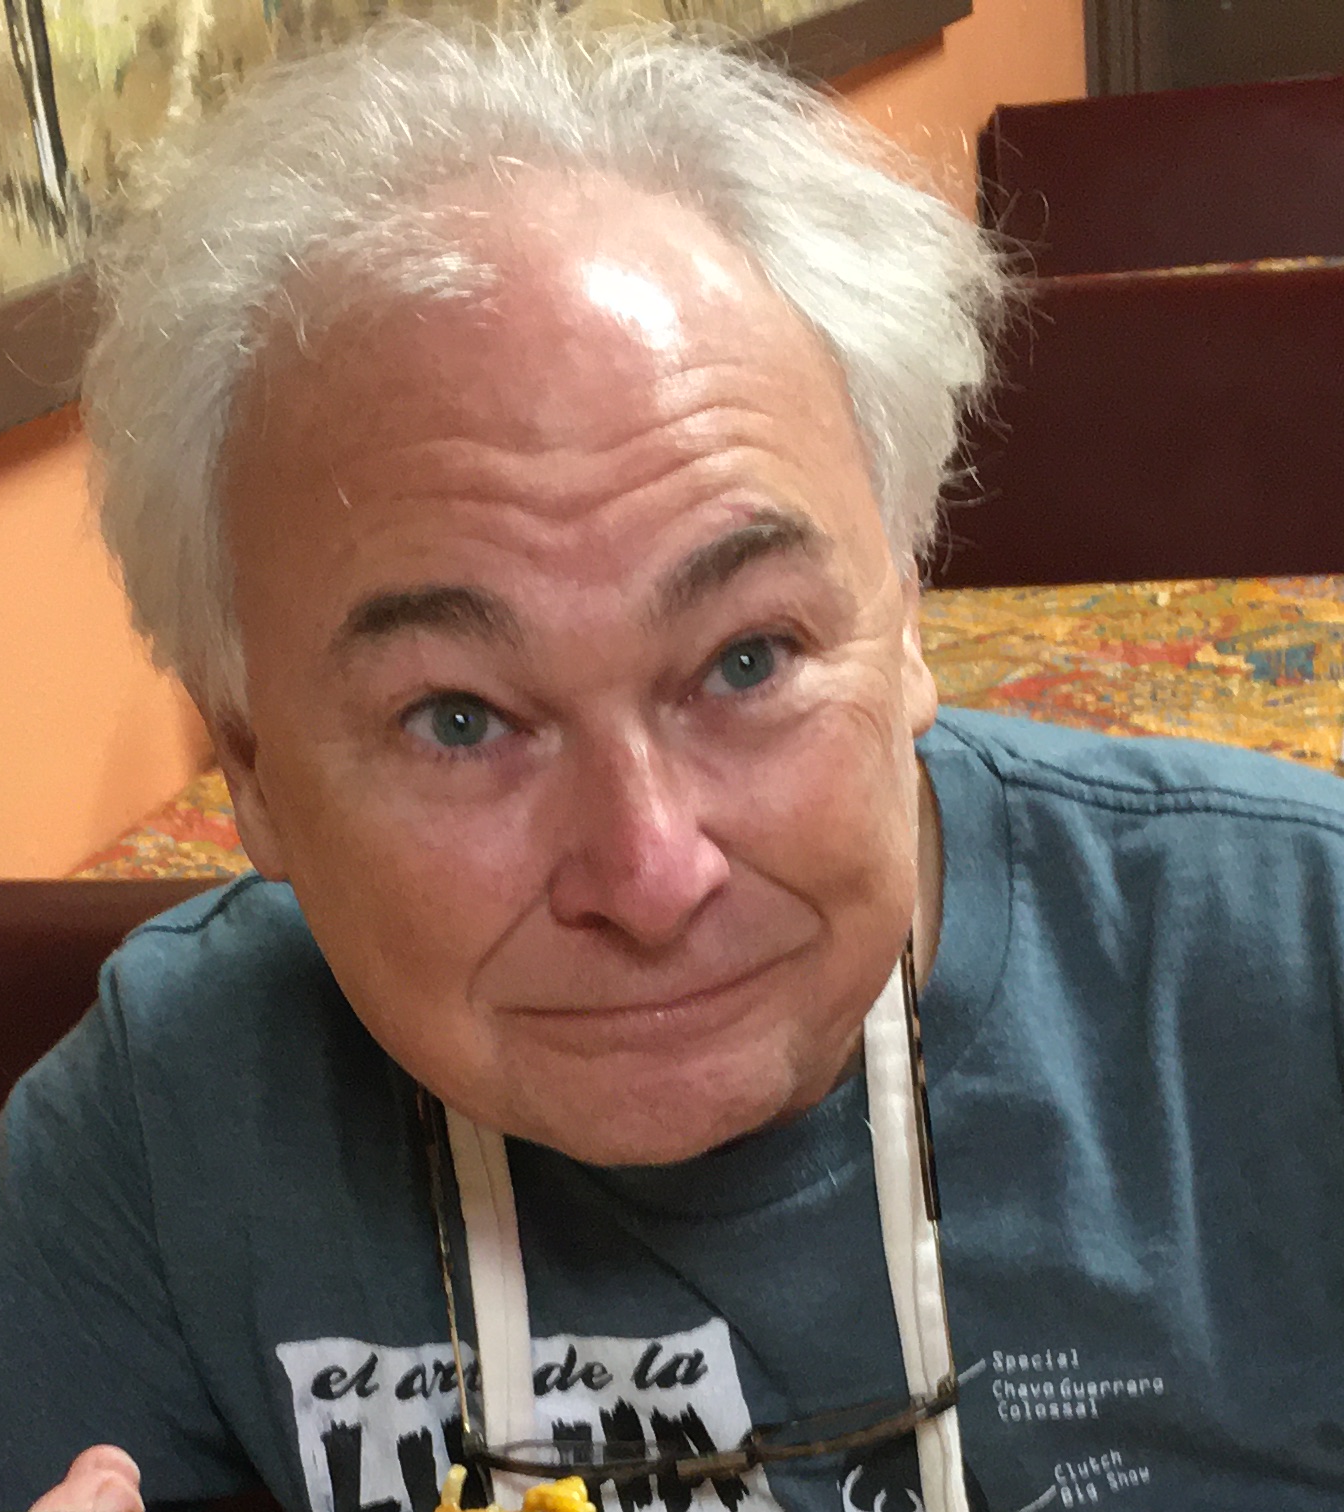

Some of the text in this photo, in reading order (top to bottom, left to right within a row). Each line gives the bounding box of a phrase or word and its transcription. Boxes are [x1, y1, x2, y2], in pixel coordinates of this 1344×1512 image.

[311, 1352, 379, 1400] el
[533, 1344, 613, 1396] de
[631, 1342, 708, 1391] la
[992, 1348, 1080, 1375] Special
[997, 1397, 1099, 1422] Colossal
[1054, 1449, 1123, 1486] Clutch
[1106, 1466, 1150, 1493] Show
